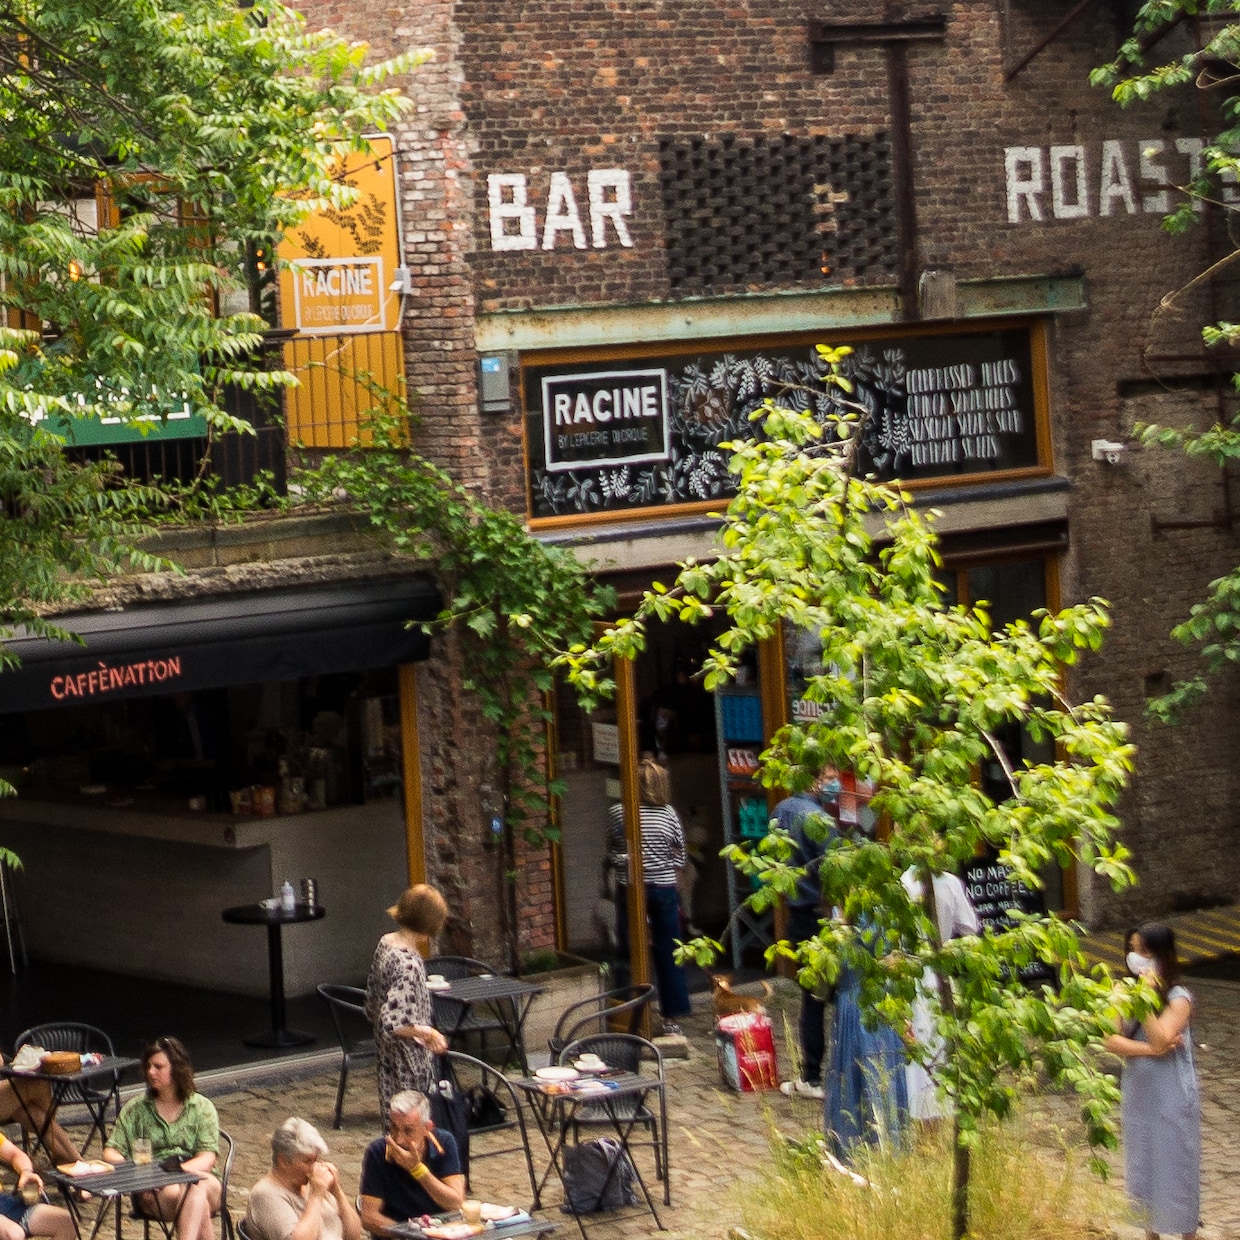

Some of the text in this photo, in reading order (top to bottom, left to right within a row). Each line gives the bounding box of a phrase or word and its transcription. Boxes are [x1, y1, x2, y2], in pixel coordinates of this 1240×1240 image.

[487, 168, 634, 252] BAR
[302, 267, 374, 298] RACINE
[554, 385, 658, 426] RACINE
[967, 864, 1014, 881] NO MAS
[965, 882, 983, 899] NO
